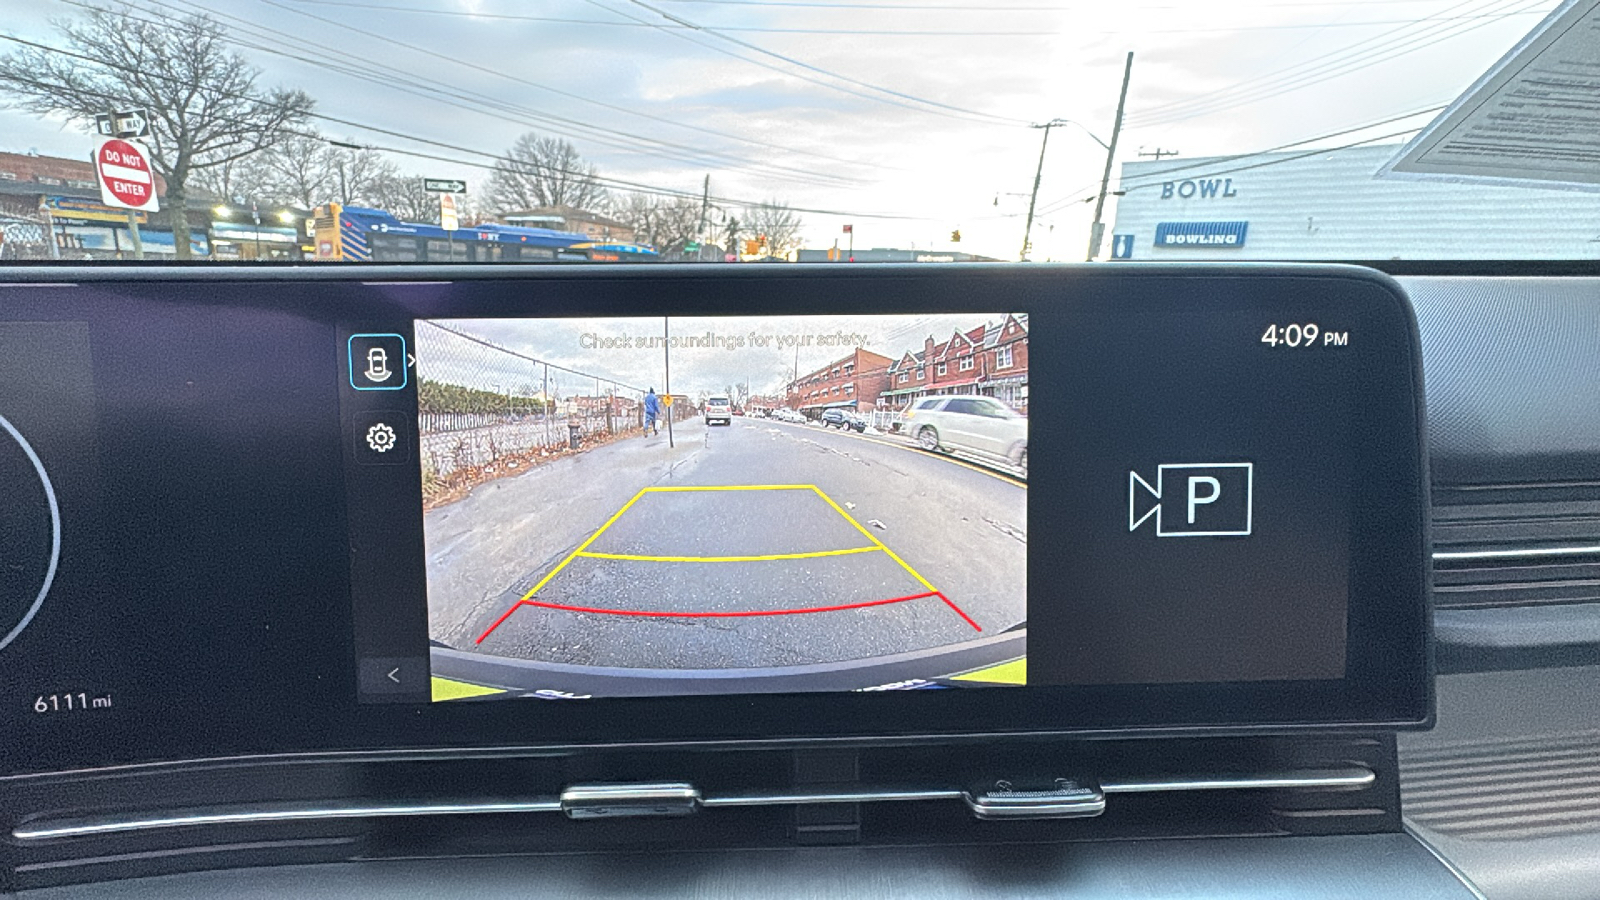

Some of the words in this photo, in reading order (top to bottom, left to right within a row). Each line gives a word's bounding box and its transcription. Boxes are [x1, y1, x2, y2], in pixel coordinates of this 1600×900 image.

[125, 119, 141, 129] WAY
[105, 149, 120, 163] DO
[122, 154, 140, 167] NOT
[113, 181, 145, 196] ENTER
[1161, 178, 1237, 199] BOWL
[1166, 234, 1238, 244] BOWLING
[579, 333, 632, 349] Check
[635, 331, 745, 351] surroundings
[748, 331, 773, 348] for
[776, 334, 813, 350] your
[816, 330, 870, 348] safety.
[1261, 323, 1319, 347] 4:09
[1324, 331, 1348, 346] PM
[1188, 476, 1221, 524] P
[34, 692, 87, 713] 6111
[92, 694, 112, 708] mi
